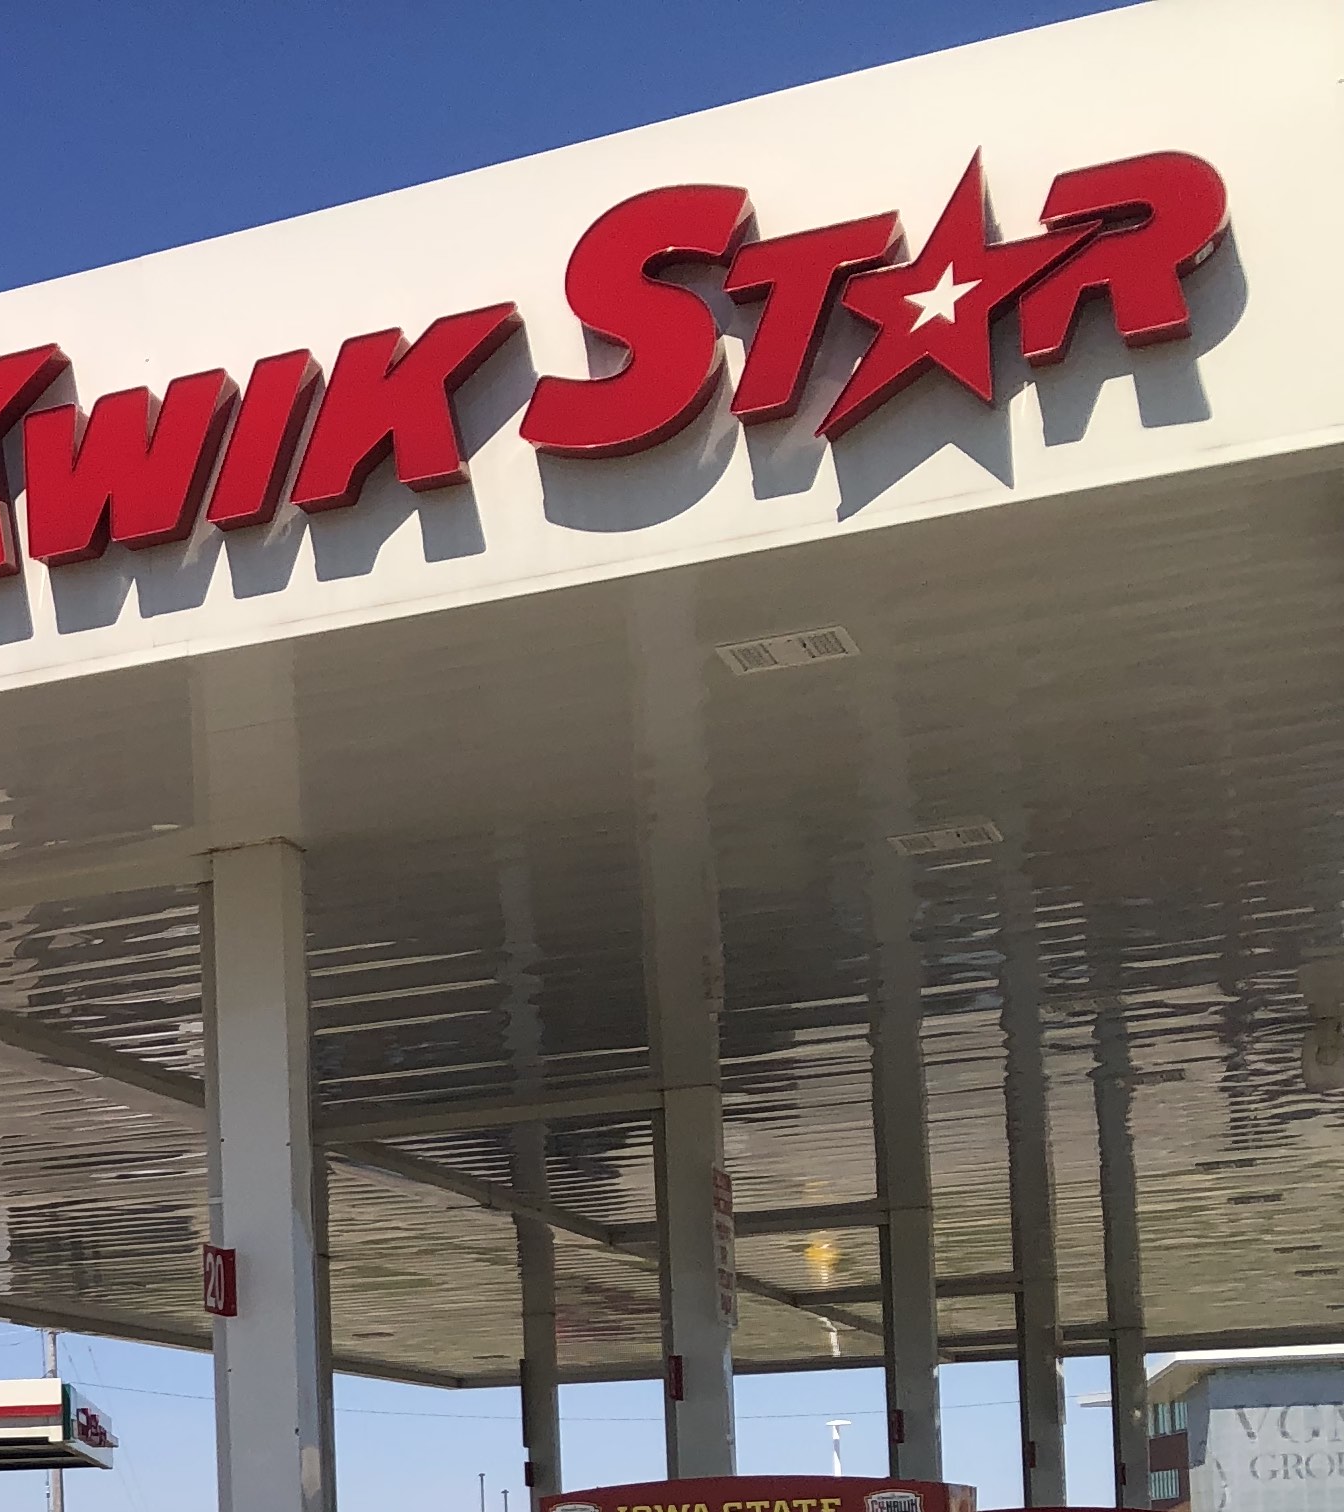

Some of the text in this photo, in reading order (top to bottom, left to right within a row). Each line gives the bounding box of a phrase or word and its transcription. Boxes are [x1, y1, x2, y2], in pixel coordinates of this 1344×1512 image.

[519, 146, 1230, 460] STAR
[206, 1252, 224, 1310] 20
[1249, 1452, 1344, 1480] GRO
